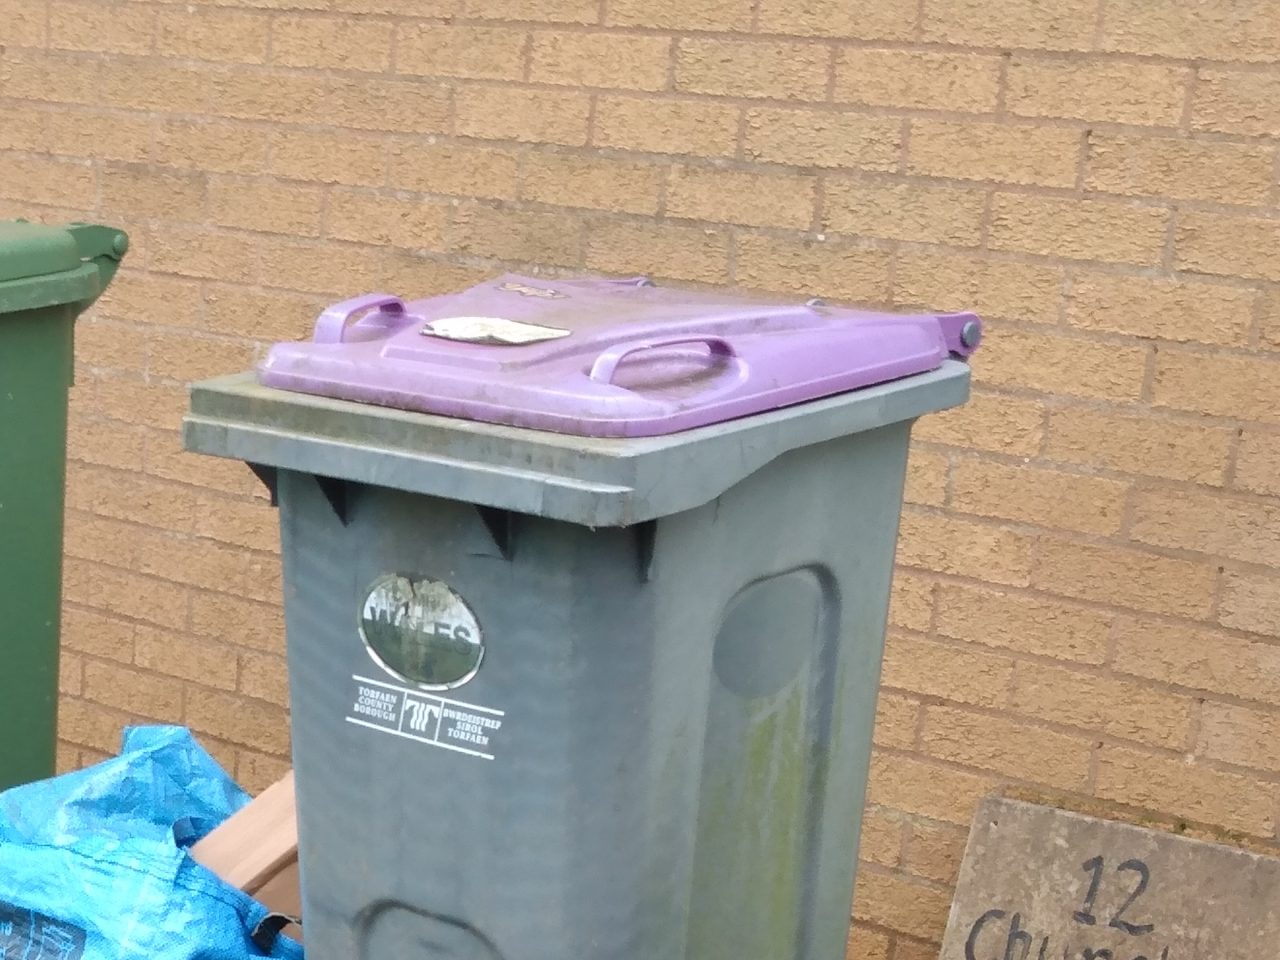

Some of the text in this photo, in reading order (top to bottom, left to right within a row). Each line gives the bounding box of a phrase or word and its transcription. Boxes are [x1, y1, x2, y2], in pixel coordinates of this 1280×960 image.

[358, 686, 398, 705] TORFAEN
[358, 695, 394, 712] COUNTY
[353, 703, 396, 722] BOROUGH
[447, 727, 489, 745] TORFAEN
[1072, 855, 1154, 936] 12
